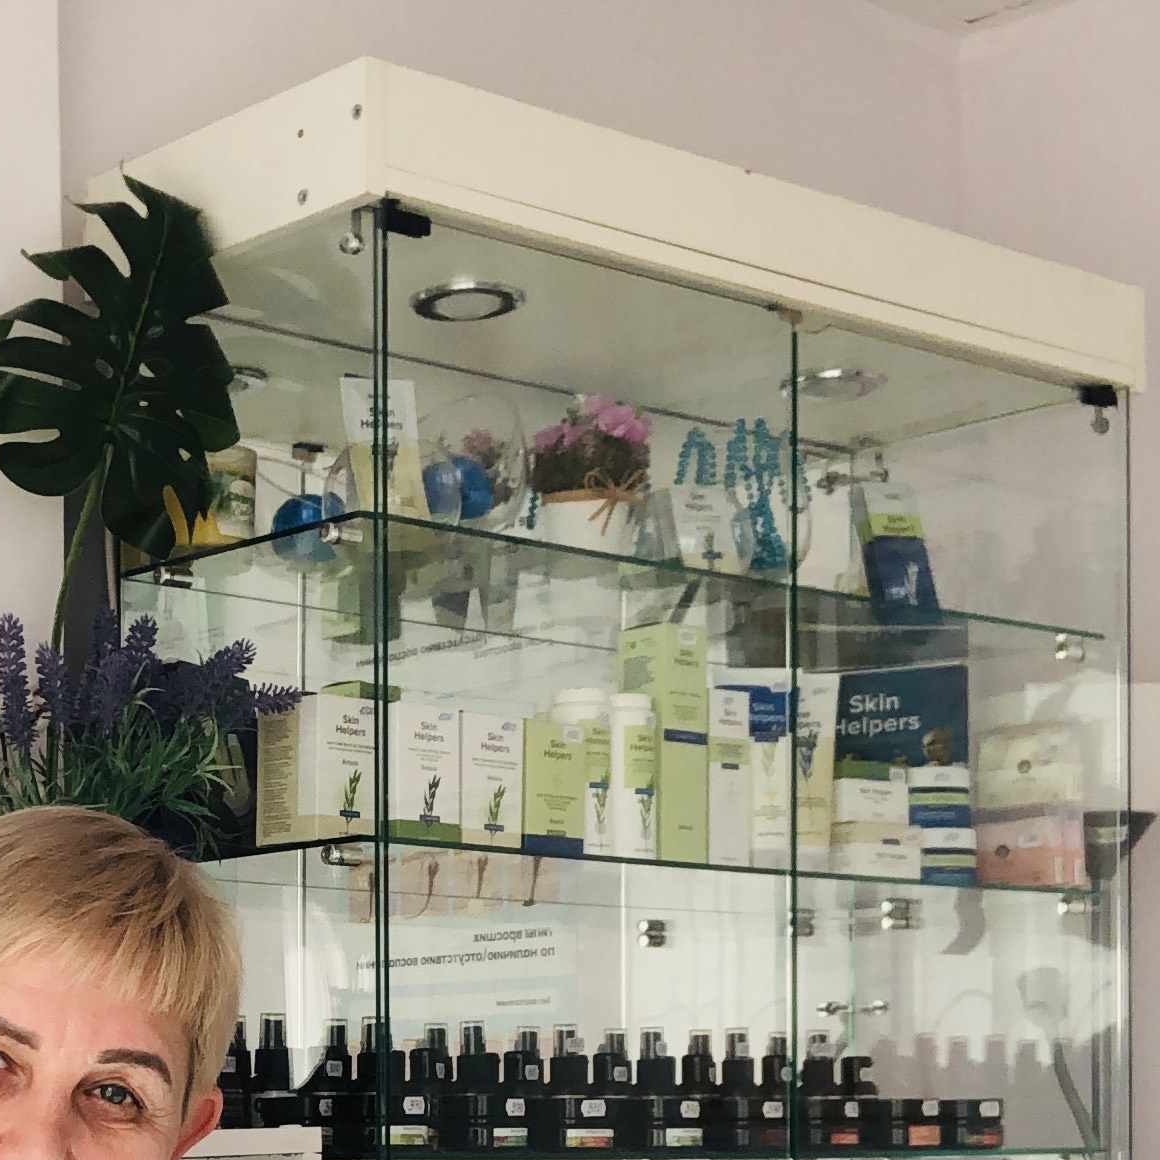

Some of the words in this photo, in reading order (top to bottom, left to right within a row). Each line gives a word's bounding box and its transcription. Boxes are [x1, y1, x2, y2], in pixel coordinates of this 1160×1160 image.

[849, 693, 899, 713] Skin
[343, 714, 359, 724] Skin
[336, 725, 366, 737] Helpers
[420, 722, 437, 731] Skin
[414, 732, 444, 742] Helpers
[487, 732, 504, 742] Skin
[481, 742, 510, 753] Helpers
[543, 749, 572, 760] Helpers
